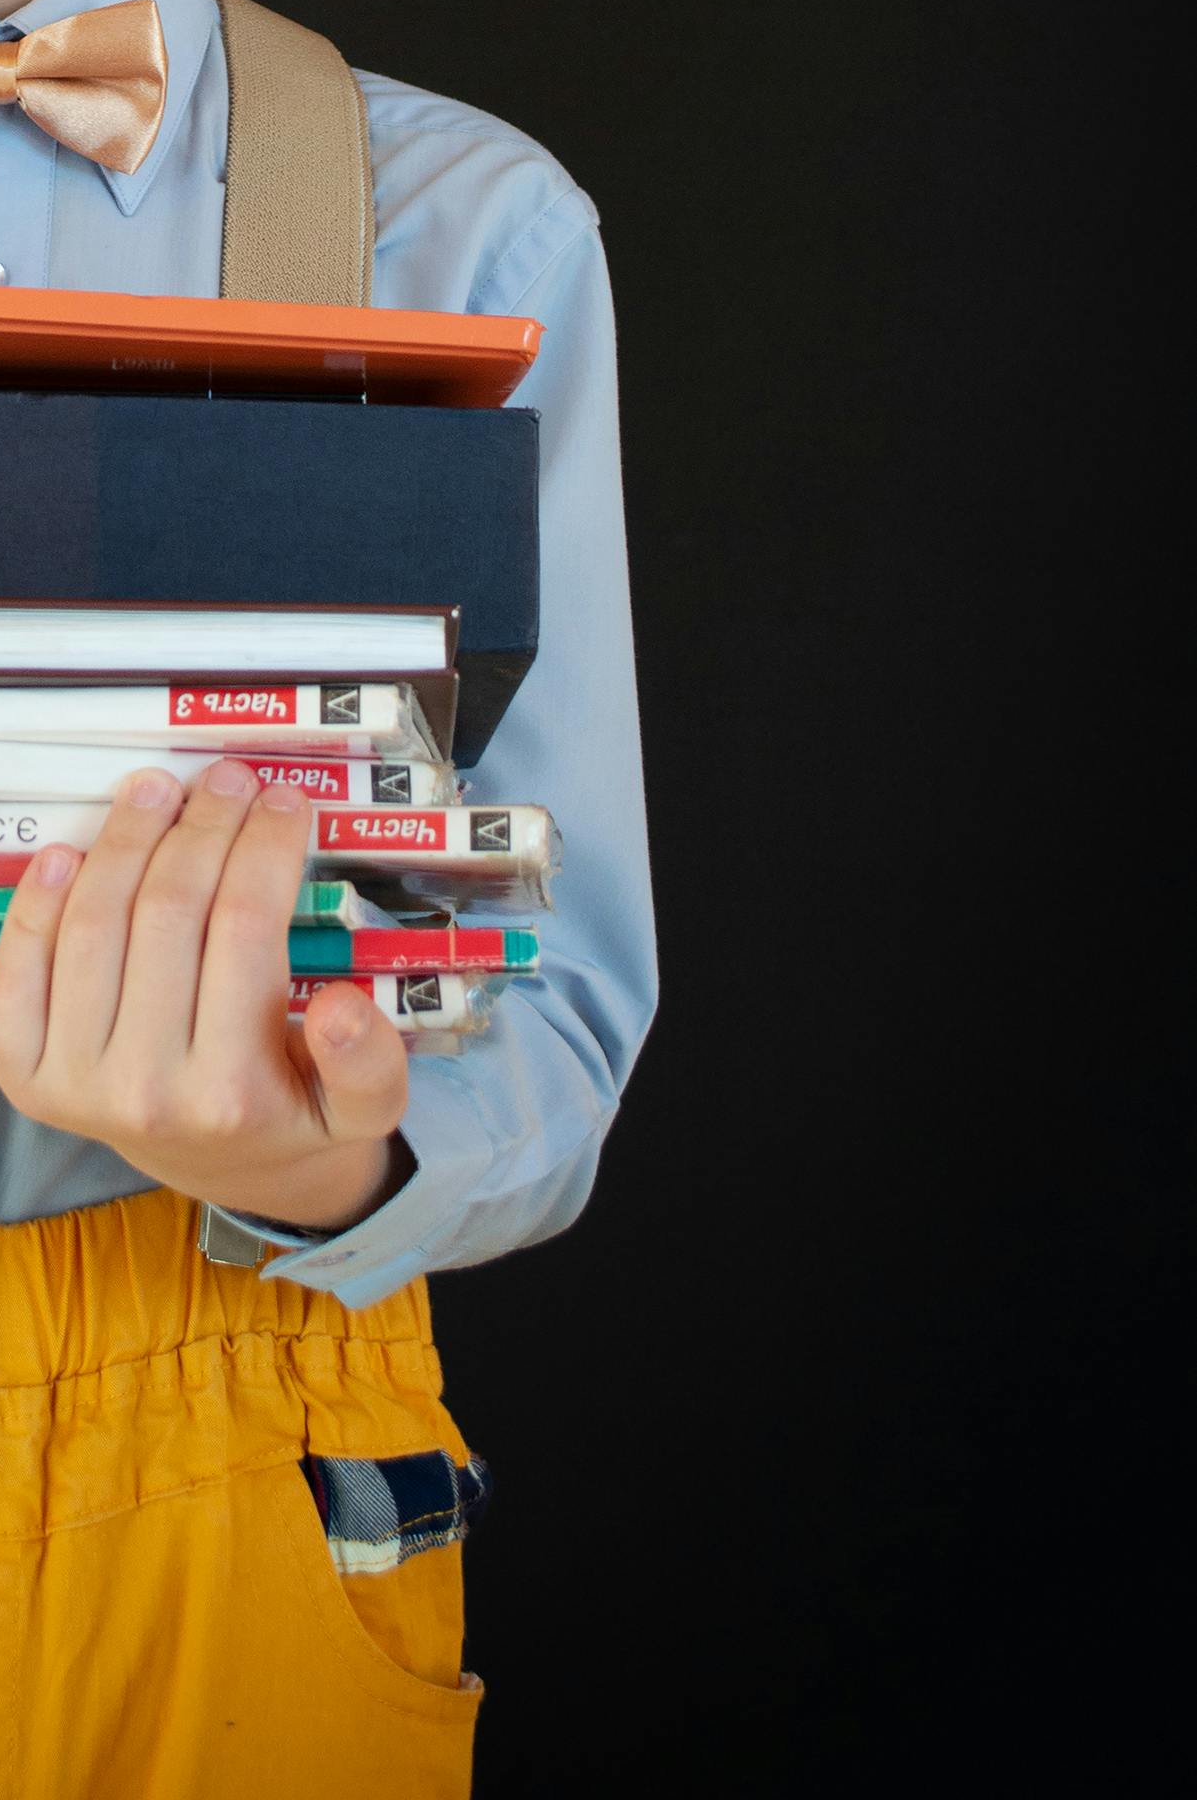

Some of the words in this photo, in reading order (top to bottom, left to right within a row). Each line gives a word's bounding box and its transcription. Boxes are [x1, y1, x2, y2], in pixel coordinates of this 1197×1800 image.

[175, 692, 194, 717] 3
[203, 691, 286, 718] Часть
[257, 764, 338, 792] Часть
[327, 817, 342, 841] 1
[352, 816, 437, 844] Часть
